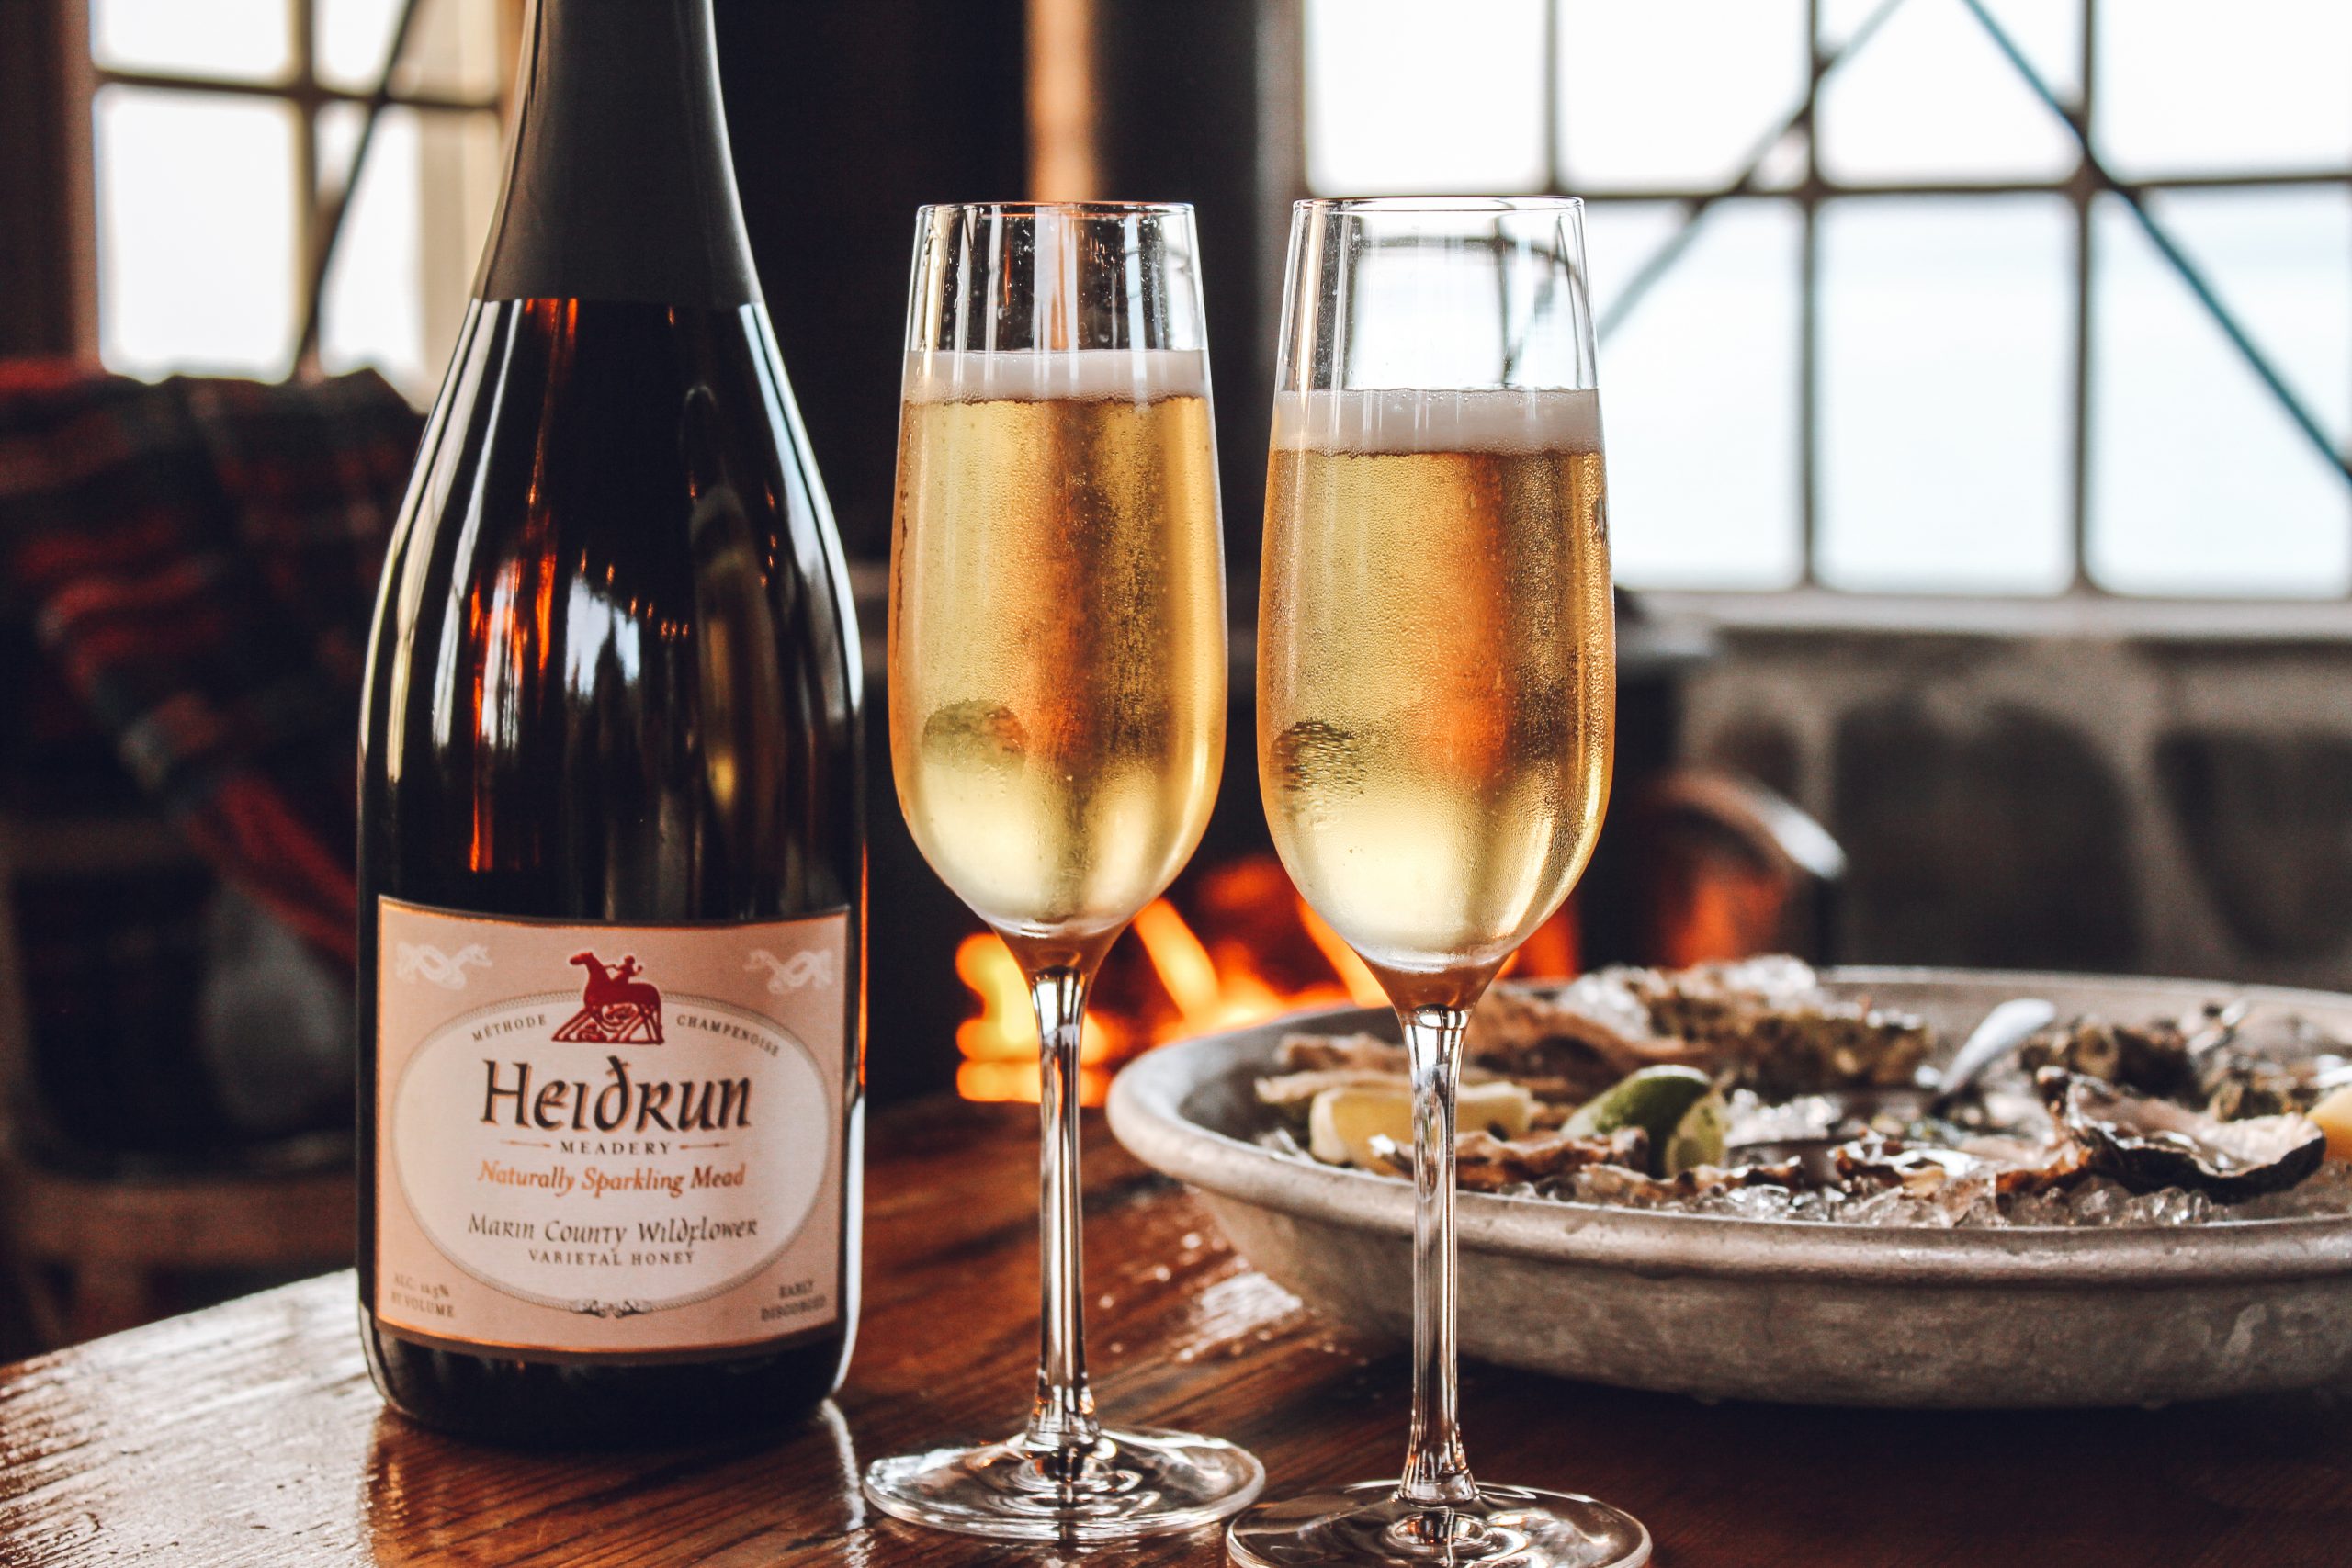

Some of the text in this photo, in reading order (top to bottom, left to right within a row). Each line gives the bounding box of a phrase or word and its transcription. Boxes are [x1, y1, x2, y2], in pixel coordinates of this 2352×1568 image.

[676, 1014, 779, 1057] CHAMPENOISE
[560, 1140, 671, 1156] MEADERY
[477, 1159, 746, 1199] Naturally Sparkling Mead
[468, 1213, 759, 1253] Marin County Wildflower
[528, 1248, 696, 1267] VARIETAL HONEY
[404, 1292, 456, 1319] VOLUME
